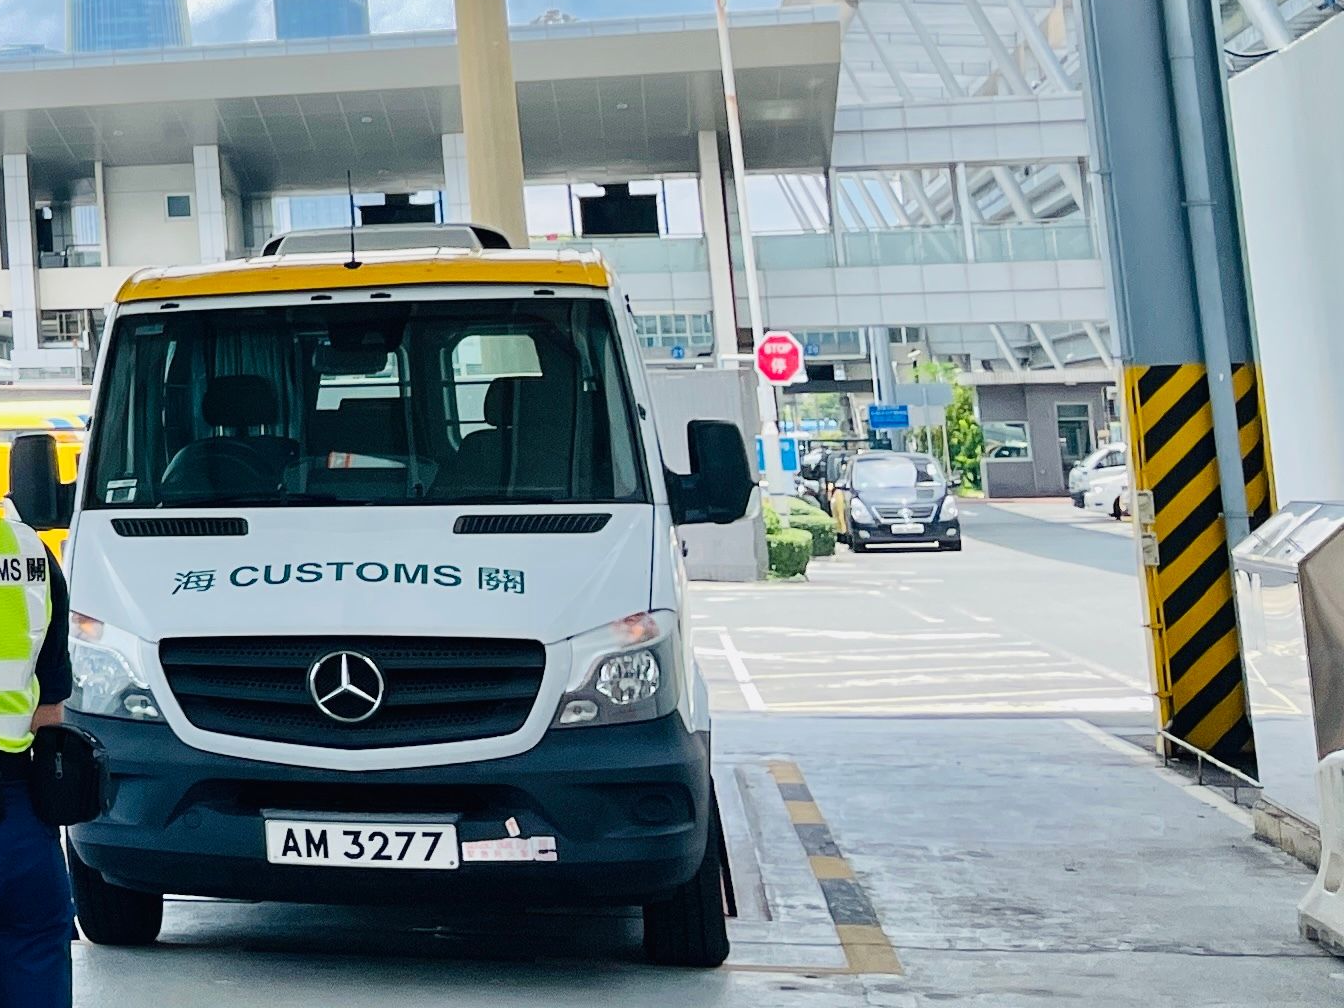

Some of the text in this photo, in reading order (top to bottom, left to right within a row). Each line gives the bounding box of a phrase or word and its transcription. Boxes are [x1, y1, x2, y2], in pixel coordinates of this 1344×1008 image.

[763, 342, 793, 354] STOP
[770, 357, 787, 374] 停
[172, 562, 524, 594] 海 CUSTOMS 關
[282, 828, 329, 858] AM
[343, 830, 443, 861] 3277
